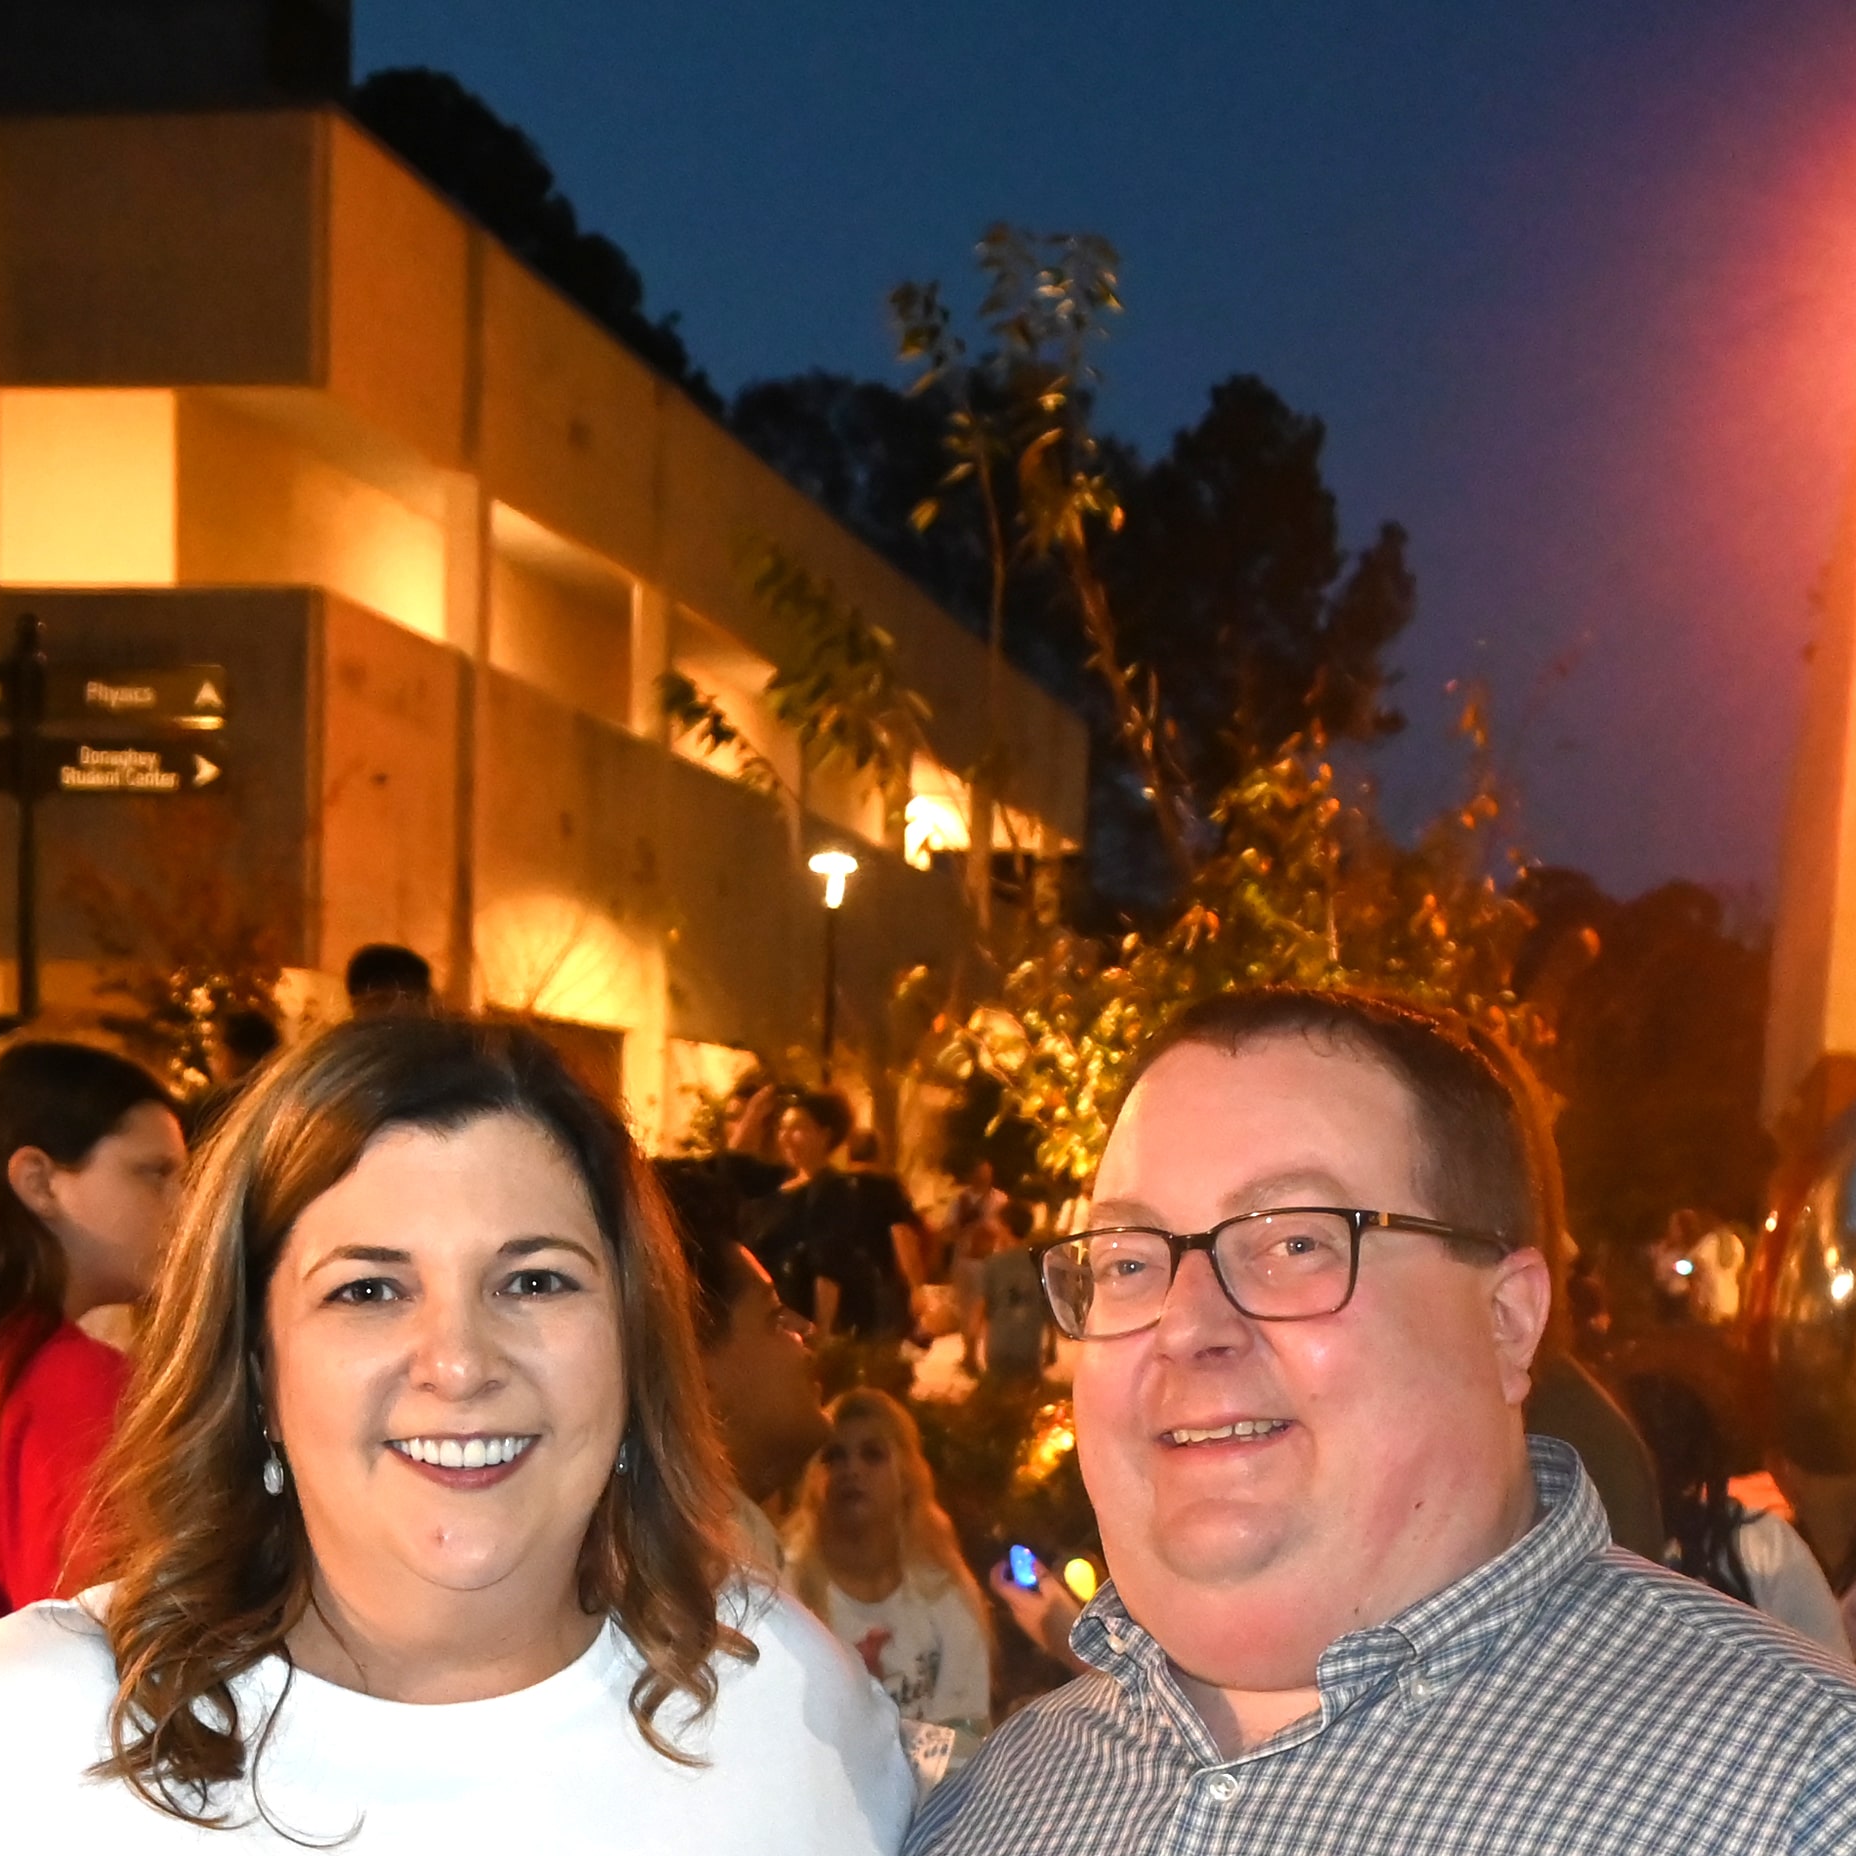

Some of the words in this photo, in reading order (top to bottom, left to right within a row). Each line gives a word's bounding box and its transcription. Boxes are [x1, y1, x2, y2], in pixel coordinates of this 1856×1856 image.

[86, 681, 155, 707] Physics
[60, 765, 120, 786] Student
[125, 767, 178, 788] Center
